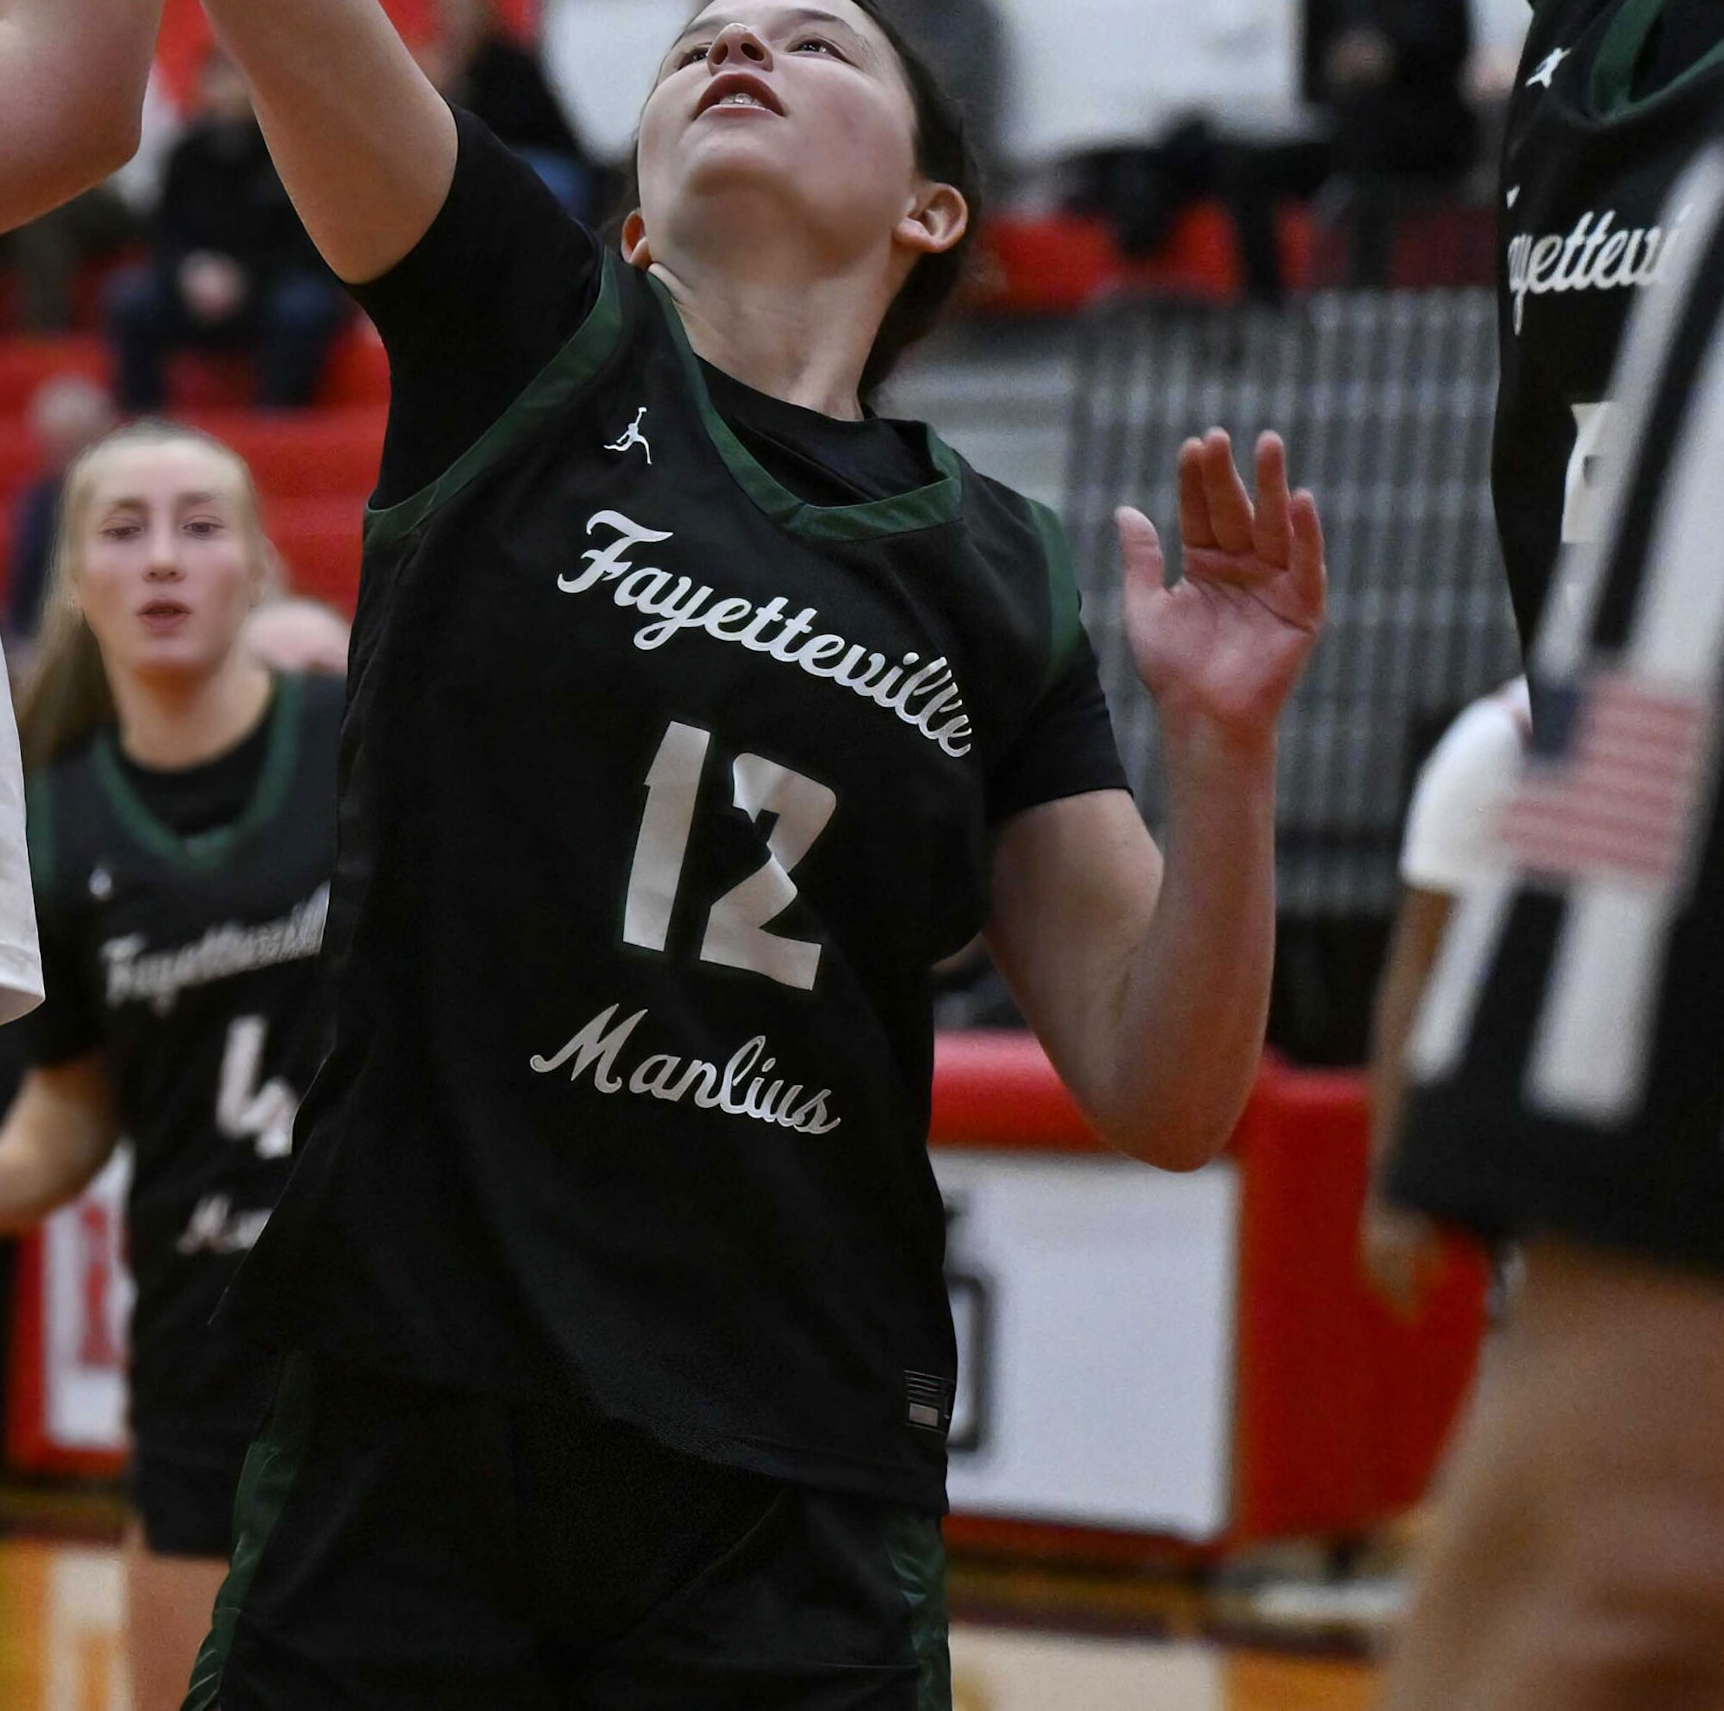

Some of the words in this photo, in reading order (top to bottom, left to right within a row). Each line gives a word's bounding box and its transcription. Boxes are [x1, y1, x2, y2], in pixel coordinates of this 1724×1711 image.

[556, 509, 973, 758] Fayetteville
[622, 719, 838, 991] 12
[529, 1001, 842, 1136] Manlius
